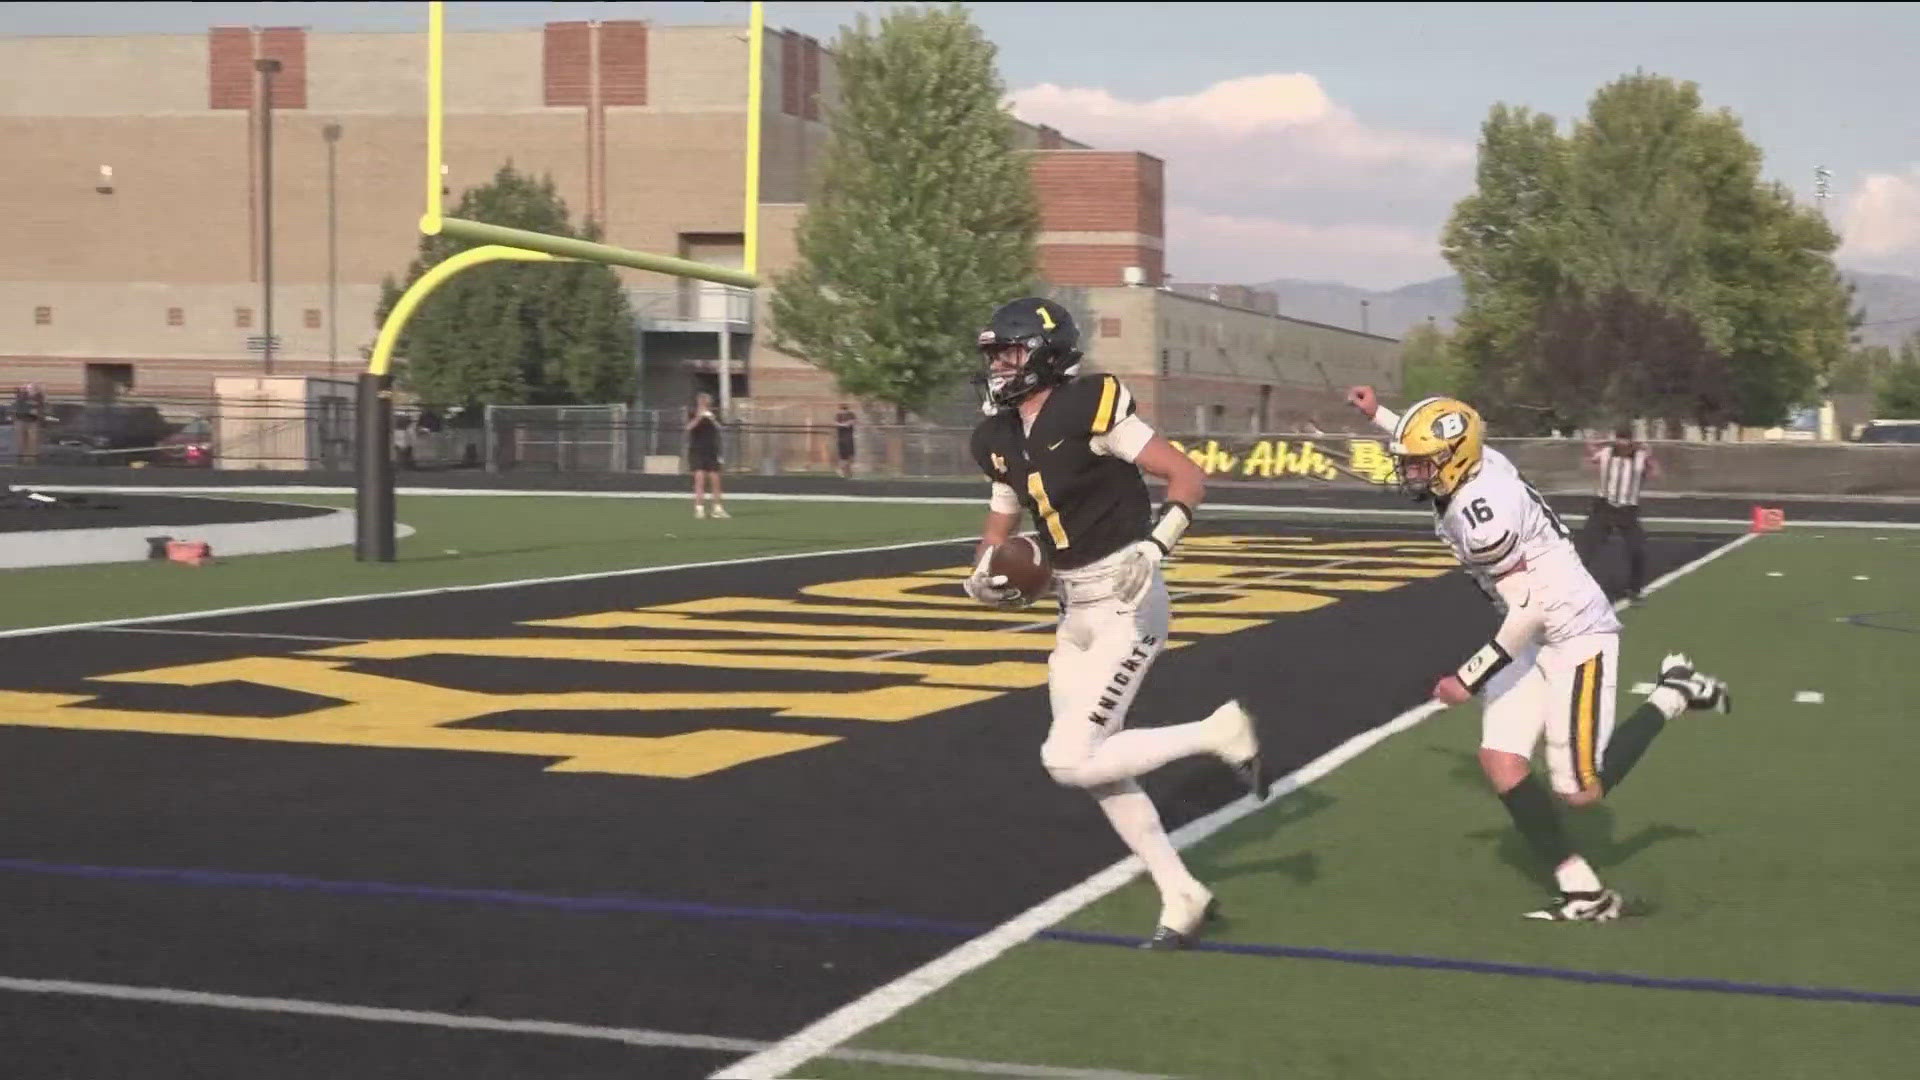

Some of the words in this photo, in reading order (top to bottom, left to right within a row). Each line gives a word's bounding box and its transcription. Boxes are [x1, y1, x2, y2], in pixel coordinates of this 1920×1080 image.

[1036, 307, 1056, 329] 1
[1438, 412, 1464, 439] B
[1243, 440, 1337, 480] Ahh,
[1028, 471, 1070, 549] 1
[1461, 496, 1495, 530] 16
[1088, 635, 1156, 726] KNIGHTS
